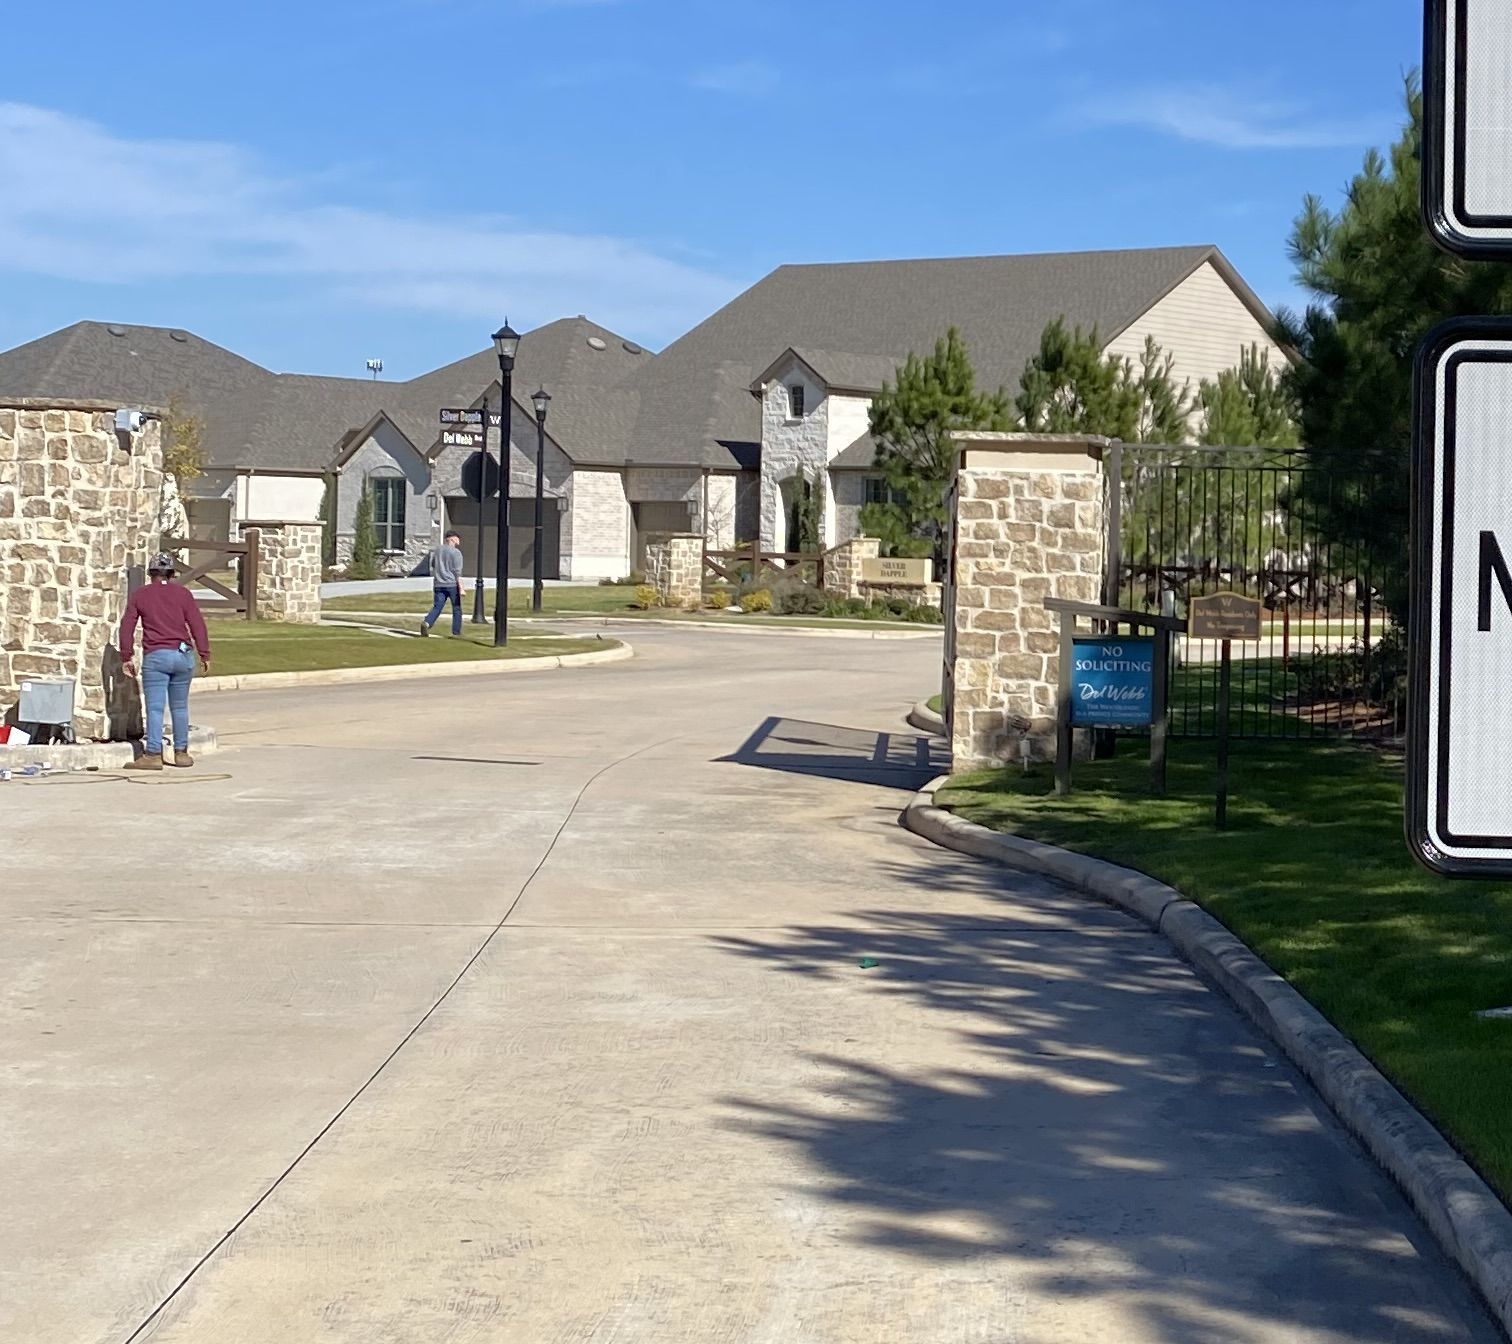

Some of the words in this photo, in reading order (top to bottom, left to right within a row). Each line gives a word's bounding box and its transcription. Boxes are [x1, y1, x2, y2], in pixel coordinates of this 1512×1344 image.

[882, 561, 906, 569] SILVER
[1102, 646, 1123, 657] NO
[1075, 659, 1152, 672] SOLICITING
[1078, 682, 1107, 700] Del
[1107, 684, 1145, 701] Webb
